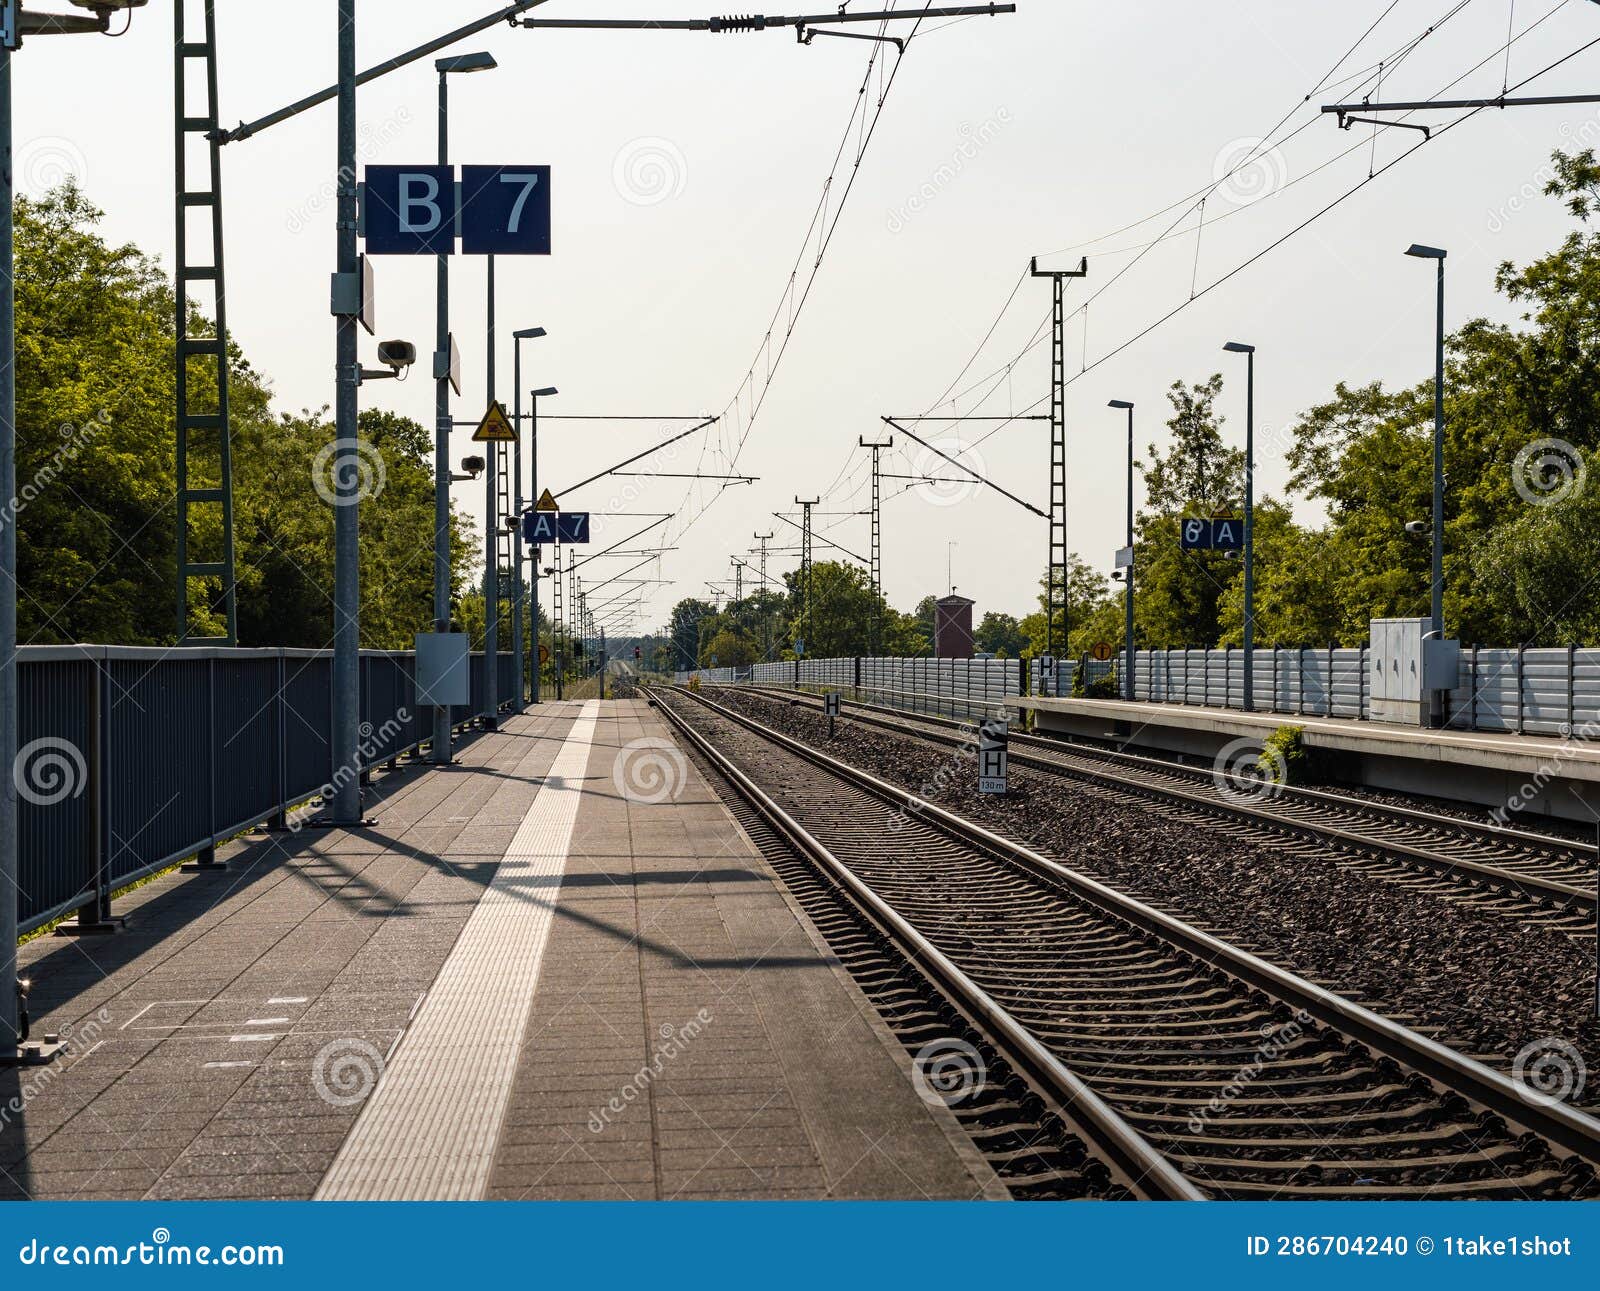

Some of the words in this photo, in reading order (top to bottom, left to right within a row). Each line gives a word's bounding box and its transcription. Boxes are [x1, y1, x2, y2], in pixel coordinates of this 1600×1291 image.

[398, 173, 442, 233] B
[499, 173, 538, 233] 7
[533, 515, 552, 537] A
[571, 515, 585, 537] 7
[1185, 521, 1200, 543] 6
[1218, 522, 1235, 543] A
[825, 694, 839, 715] H
[984, 751, 1002, 776] H
[981, 781, 995, 790] 130
